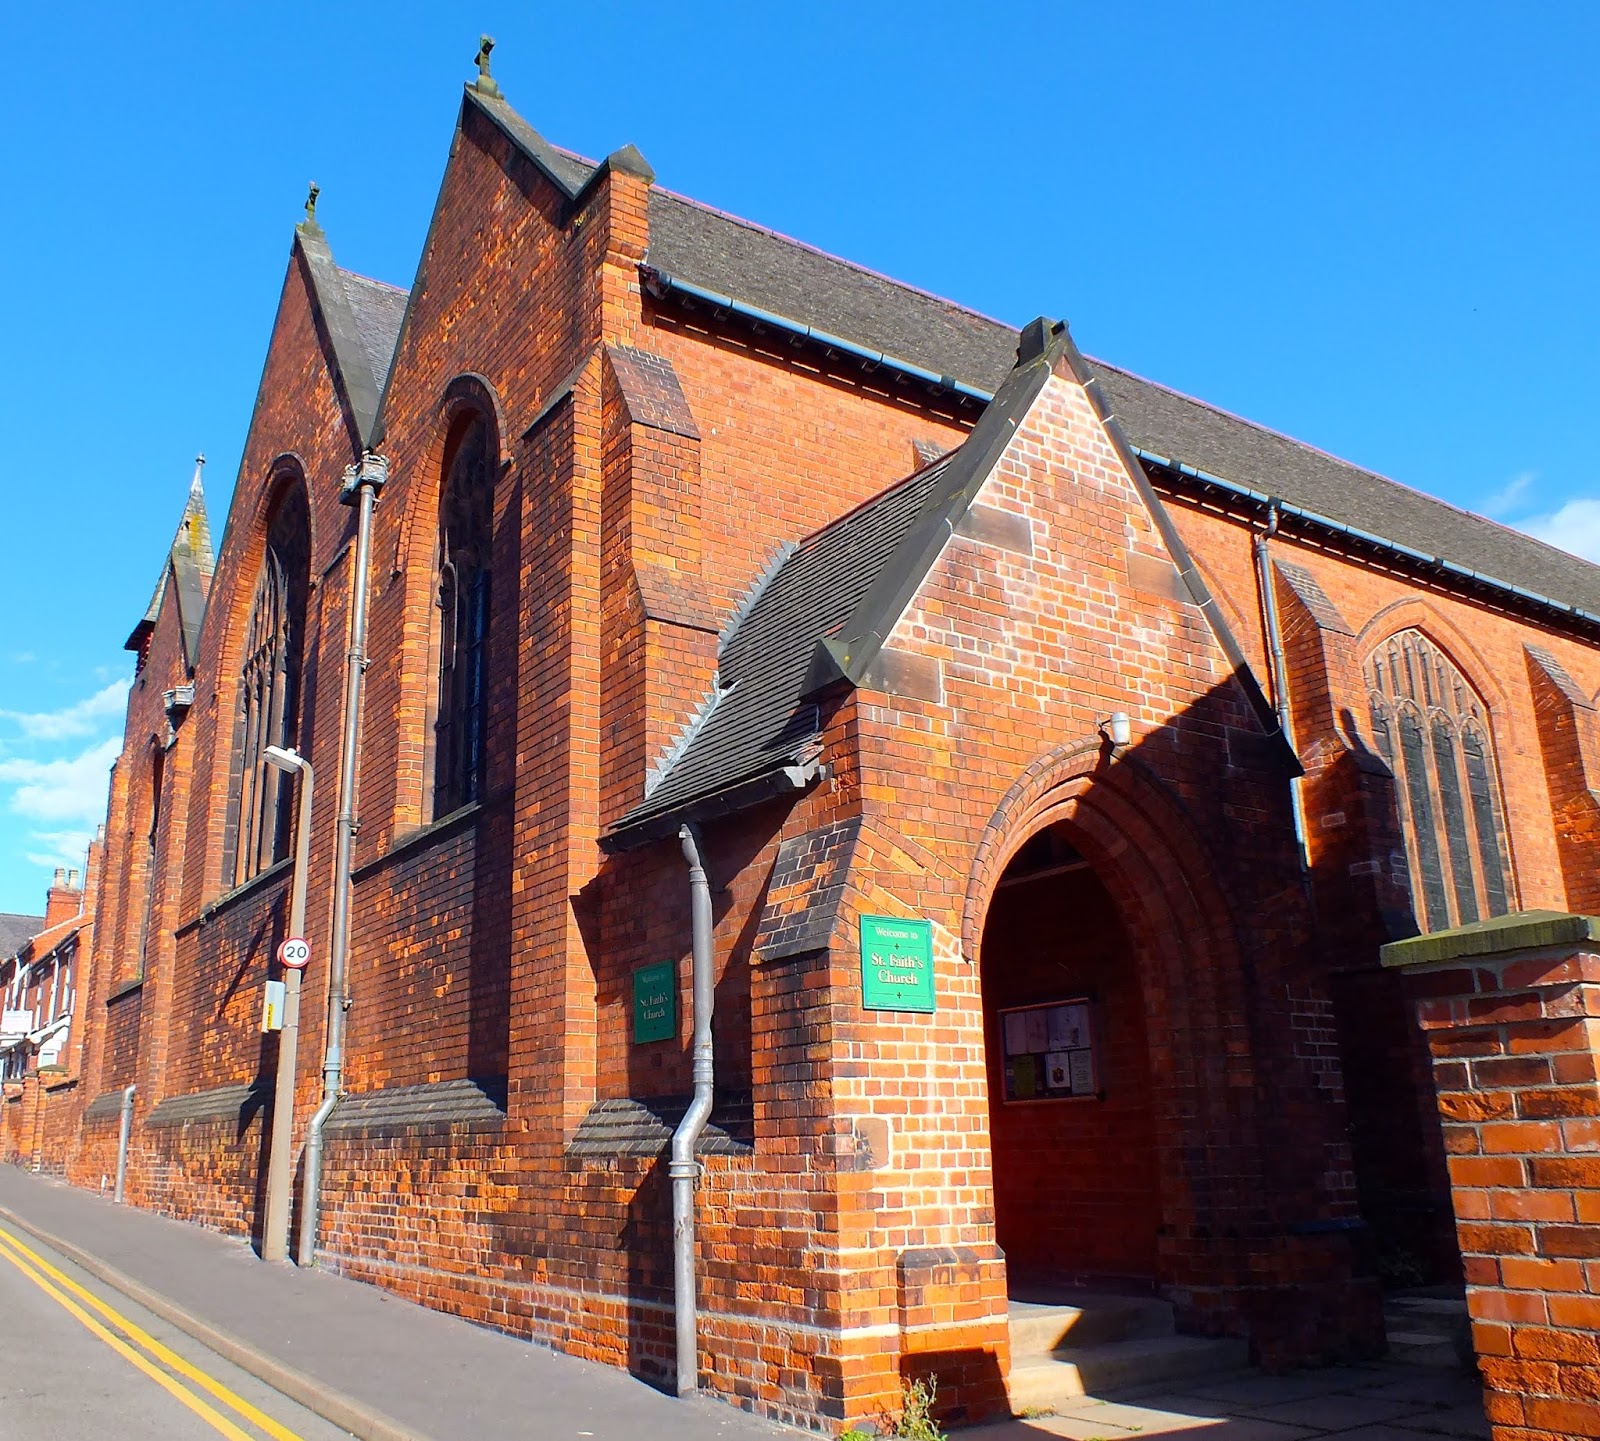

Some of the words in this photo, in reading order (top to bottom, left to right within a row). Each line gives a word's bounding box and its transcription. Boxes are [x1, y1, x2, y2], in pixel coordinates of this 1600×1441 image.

[875, 927, 908, 939] Welcome
[286, 946, 307, 958] 20
[871, 952, 887, 966] St.
[889, 953, 924, 969] Faith's
[878, 969, 918, 985] Church
